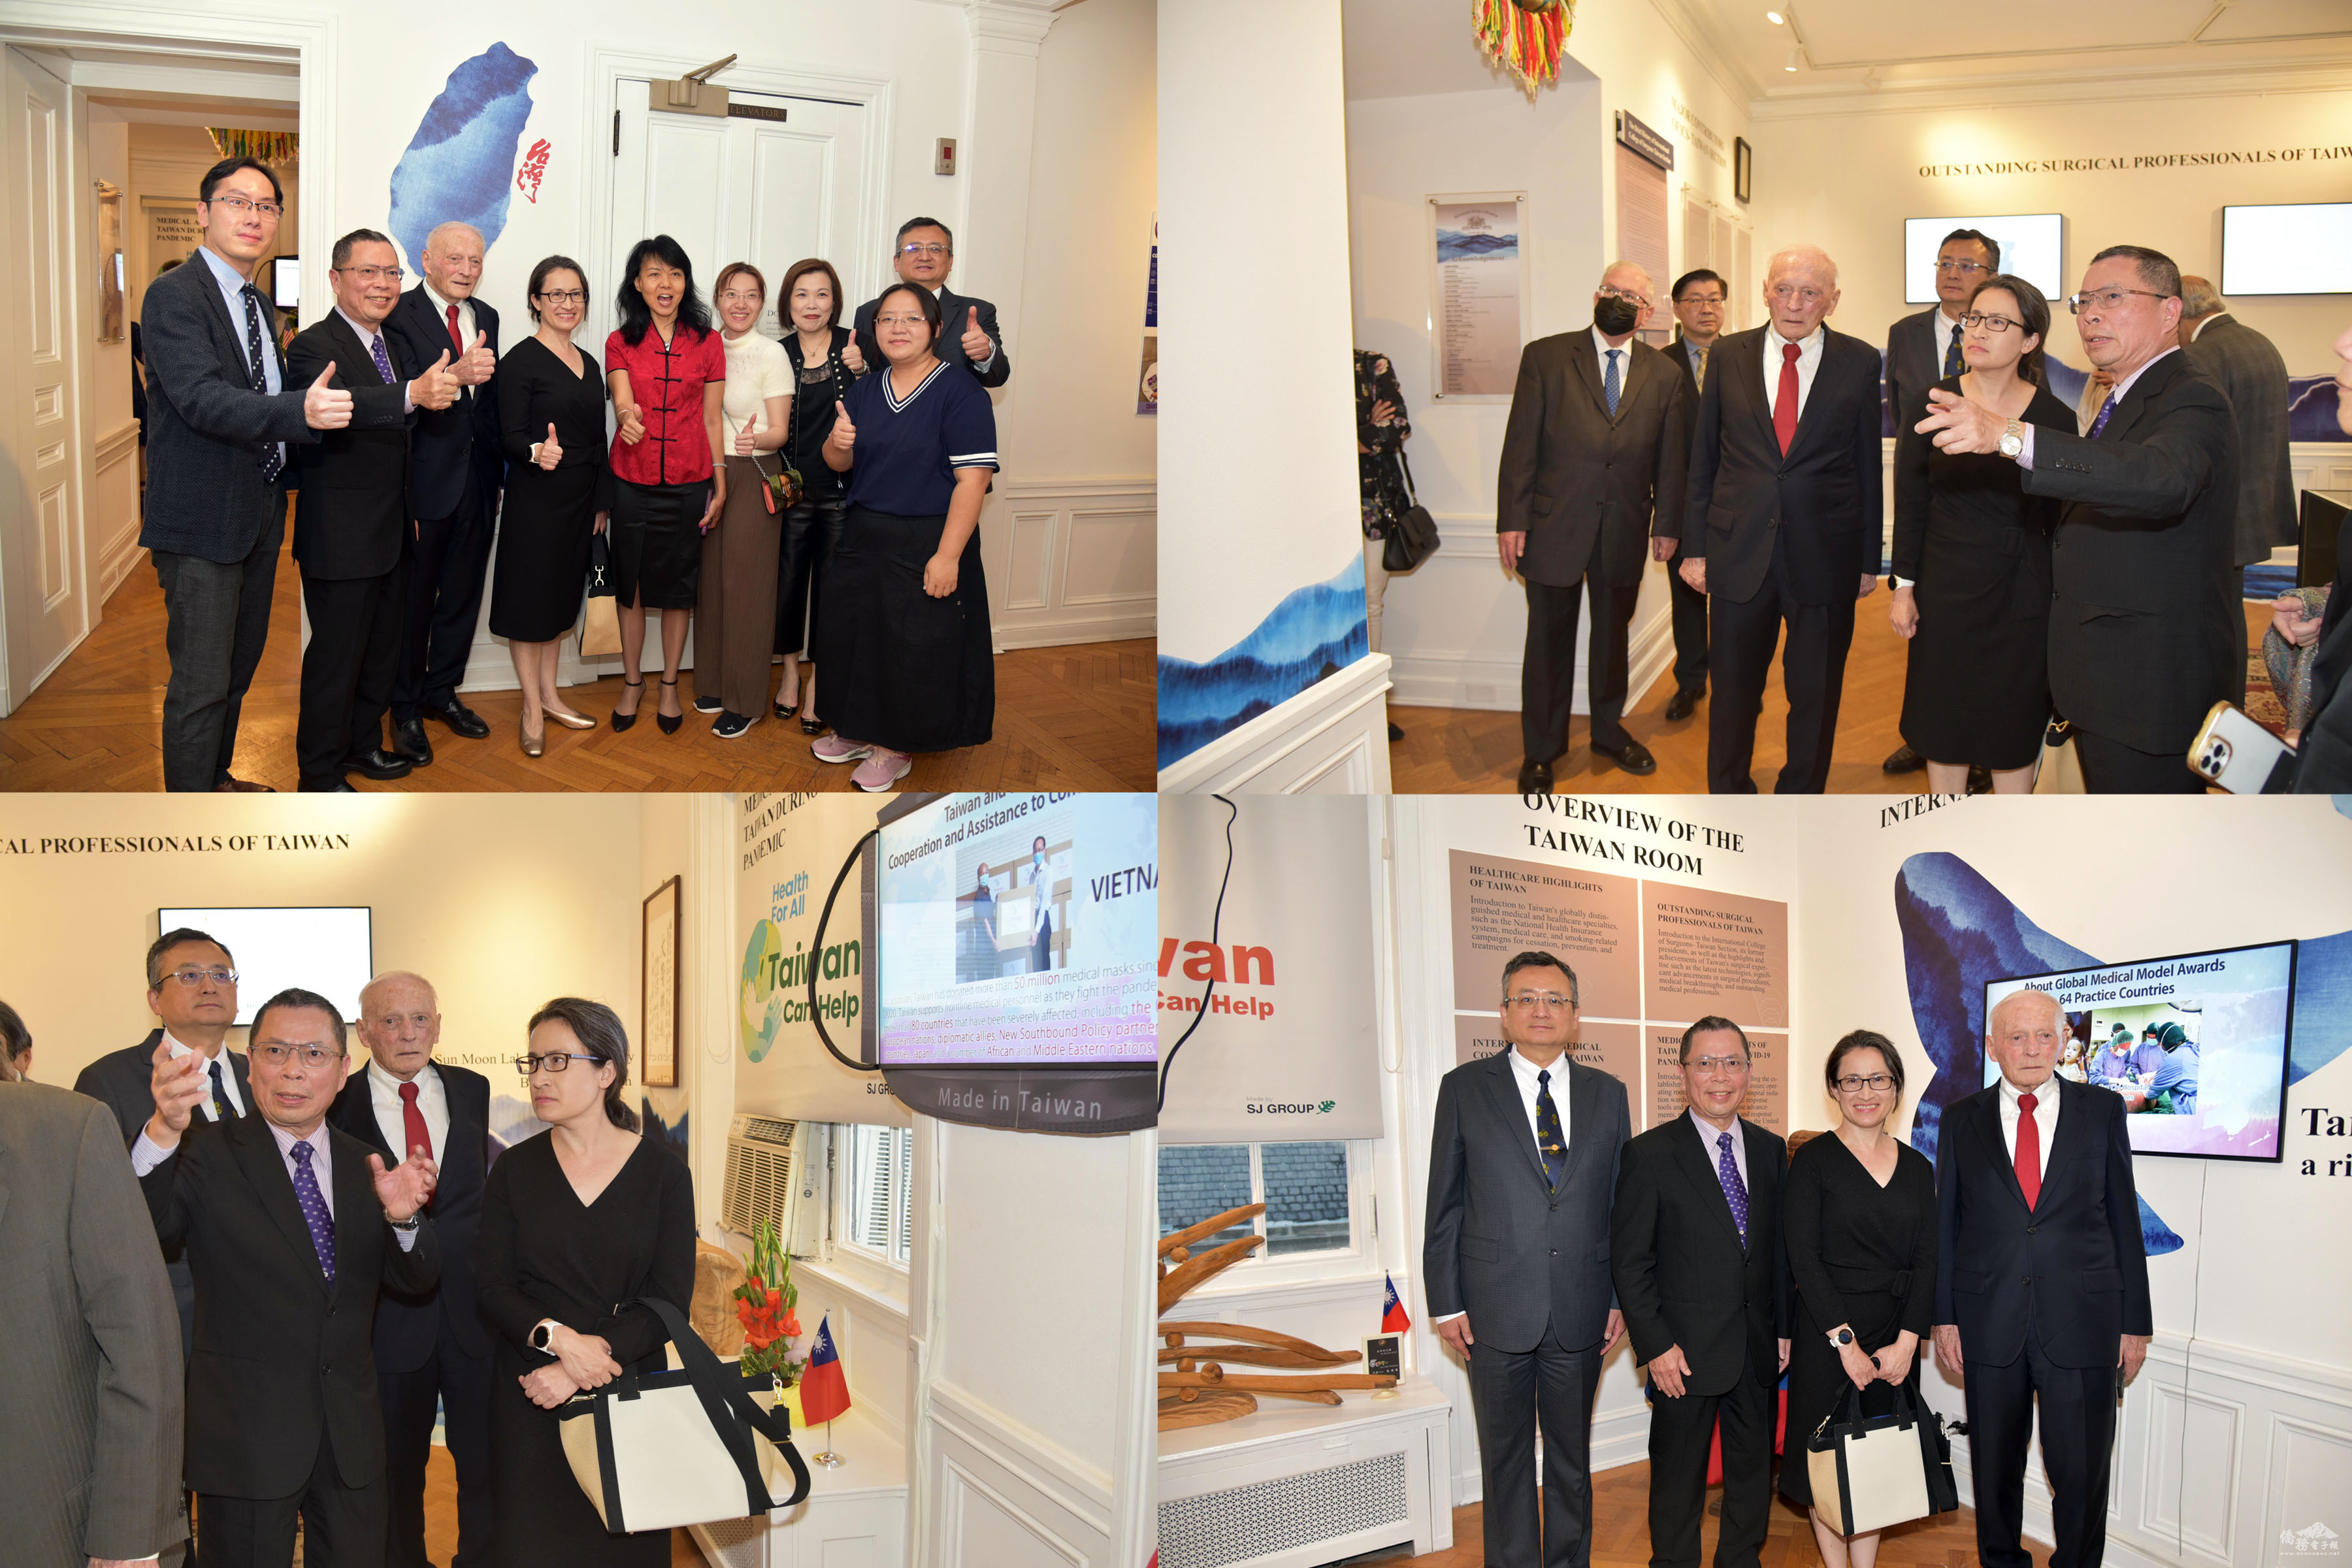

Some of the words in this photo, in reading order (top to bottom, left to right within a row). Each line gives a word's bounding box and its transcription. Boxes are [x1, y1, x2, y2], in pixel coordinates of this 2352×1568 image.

[730, 105, 784, 118] ELEVATORS
[1919, 161, 2036, 178] OUTSTANDING
[2042, 157, 2130, 172] SURGICAL
[2134, 150, 2276, 169] PROFESSIONALS
[2282, 149, 2306, 162] OF
[944, 796, 981, 823] Taiwan
[889, 834, 942, 870] Cooperation
[945, 825, 964, 846] and
[967, 802, 1028, 838] Assistance
[1031, 794, 1045, 811] to
[1523, 794, 1661, 834] OVERVIEW
[1668, 821, 1697, 841] OF
[1702, 827, 1744, 853] THE
[41, 836, 222, 853] PROFESSIONALS
[229, 836, 258, 851] OF
[263, 834, 350, 850] TAIWAN
[743, 828, 786, 871] PANDEMIC
[1524, 825, 1625, 861] TAIWAN
[1633, 845, 1703, 875] ROOM
[773, 870, 808, 903] Health
[1469, 866, 1540, 883] HEALTHCARE
[1543, 877, 1603, 892] HIGHLIGHTS
[1486, 881, 1527, 893] TAIWAN
[772, 906, 787, 925] For
[789, 894, 805, 919] All
[1471, 896, 1516, 908] Introduction
[1527, 904, 1558, 914] Taiwan's
[1560, 908, 1586, 919] globally
[1588, 911, 1609, 920] distin-
[1471, 907, 1499, 915] guished
[1502, 909, 1530, 919] medical
[1532, 913, 1544, 921] and
[1547, 915, 1581, 926] healthcare
[1583, 919, 1618, 930] specialties,
[1658, 903, 1714, 917] OUTSTANDING
[1716, 913, 1754, 923] SURGICAL
[1471, 926, 1499, 934] system,
[1502, 928, 1530, 936] medical
[1565, 934, 1617, 946] smoking-related
[1514, 919, 1543, 929] National
[1546, 923, 1568, 932] Health
[1571, 926, 1602, 936] Insurance
[1658, 915, 1722, 930] PROFESSIONALS
[1735, 926, 1763, 935] TAIWAN
[1472, 934, 1511, 944] campaigns
[1526, 940, 1560, 949] cessation,
[1561, 943, 1599, 953] prevention,
[1472, 943, 1509, 952] treatment.
[1658, 929, 1693, 940] Introduction
[1712, 936, 1745, 946] International
[1746, 941, 1765, 950] College
[768, 939, 860, 991] Taiwan
[2055, 975, 2087, 990] Global
[2091, 969, 2132, 986] Medical
[2136, 964, 2174, 981] Model
[2177, 958, 2225, 976] Awards
[935, 990, 945, 999] has
[947, 985, 973, 998] donated
[975, 984, 993, 993] more
[996, 981, 1012, 991] than
[1015, 977, 1024, 990] 50
[1028, 974, 1060, 987] million
[1064, 966, 1100, 983] medical
[1103, 962, 1134, 975] masks
[1736, 984, 1765, 993] outstanding
[899, 1007, 917, 1017] Taiwan
[919, 1004, 943, 1015] supports
[945, 1002, 971, 1012] frontline
[973, 997, 1000, 1009] medical
[1003, 991, 1041, 1009] personnel
[1044, 992, 1053, 1002] as
[1055, 989, 1075, 1003] they
[1077, 985, 1099, 1002] fight
[1103, 983, 1119, 996] the
[2059, 992, 2072, 1005] 64
[2075, 988, 2116, 1004] Practice
[2119, 983, 2174, 998] Countries
[818, 990, 859, 1027] Help
[911, 1021, 919, 1031] 80
[921, 1019, 953, 1030] countries
[955, 1018, 968, 1026] that
[969, 1016, 985, 1026] have
[988, 1015, 1005, 1025] been
[1008, 1009, 1039, 1024] severely
[1041, 1008, 1079, 1021] affected,
[1082, 1004, 1128, 1019] including
[1132, 1000, 1151, 1015] the
[1211, 994, 1274, 1021] Help
[885, 1037, 910, 1046] European
[912, 1034, 936, 1045] nations,
[938, 1033, 974, 1043] diplomatic
[976, 1030, 997, 1042] allies,
[1000, 1029, 1018, 1040] New
[1021, 1024, 1077, 1040] Southbound
[1081, 1022, 1112, 1039] Policy
[435, 1054, 457, 1065] Sun
[462, 1054, 497, 1064] Moon
[885, 1051, 911, 1060] countries,
[913, 1050, 932, 1059] Japan,
[933, 1049, 944, 1058] and
[951, 1049, 977, 1057] number
[979, 1048, 987, 1056] of
[987, 1046, 1014, 1057] African
[1017, 1045, 1031, 1056] and
[1033, 1045, 1066, 1056] Middle
[1069, 1043, 1105, 1056] Eastern
[1109, 1041, 1155, 1055] nations.
[867, 1084, 877, 1095] SJ
[939, 1087, 984, 1109] Made
[992, 1089, 1009, 1111] in
[1019, 1091, 1102, 1120] Taiwan
[1247, 1104, 1262, 1113] SJ
[1267, 1104, 1315, 1113] GROUP
[2301, 1160, 2317, 1175] a
